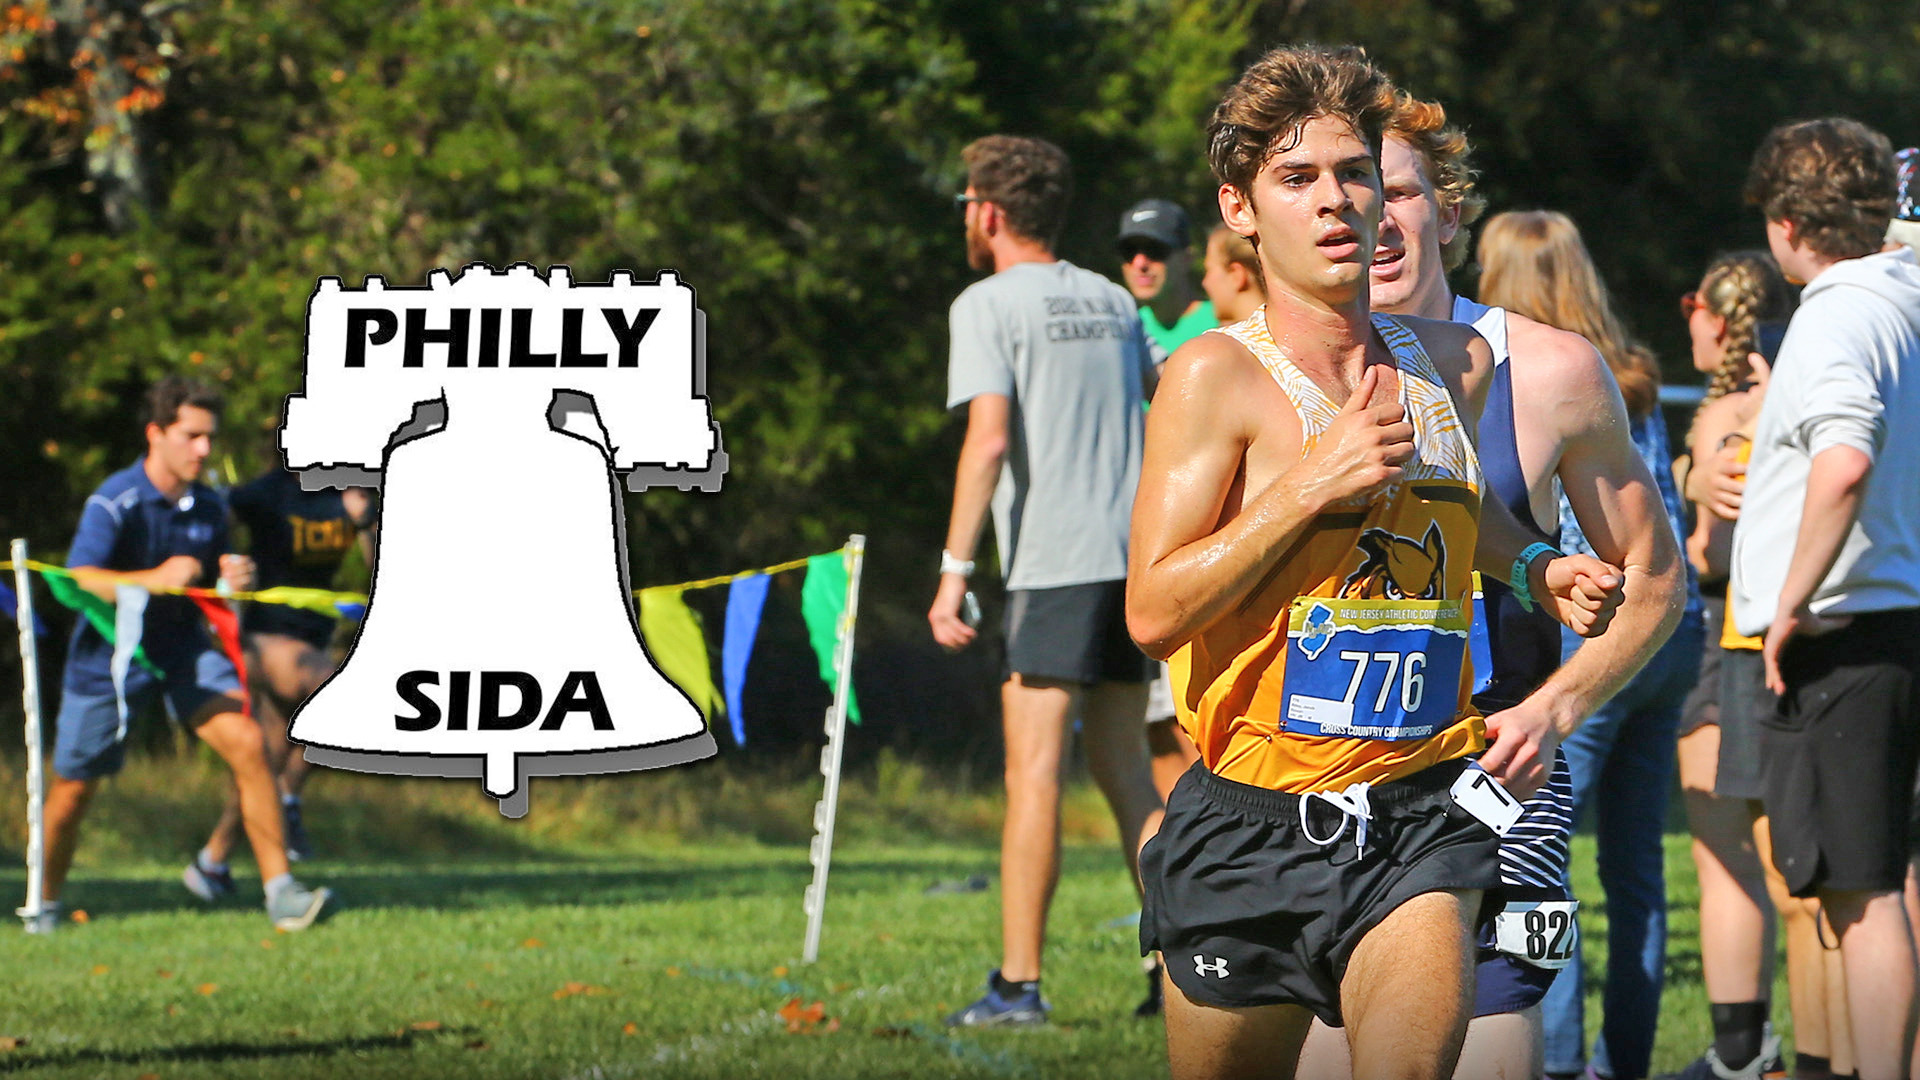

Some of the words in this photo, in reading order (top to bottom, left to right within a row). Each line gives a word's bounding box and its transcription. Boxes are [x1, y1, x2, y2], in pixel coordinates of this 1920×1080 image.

[1340, 609, 1358, 619] NEW
[1360, 609, 1385, 620] JERSEY
[1386, 609, 1418, 620] ATHLETIC
[1420, 608, 1459, 620] CONFERENCE
[1340, 650, 1427, 713] 776
[1320, 722, 1347, 735] CROSS
[1347, 725, 1384, 737] COUNTRY
[1384, 725, 1433, 738] CHAMPIONSHIPS
[1472, 773, 1510, 808] 7
